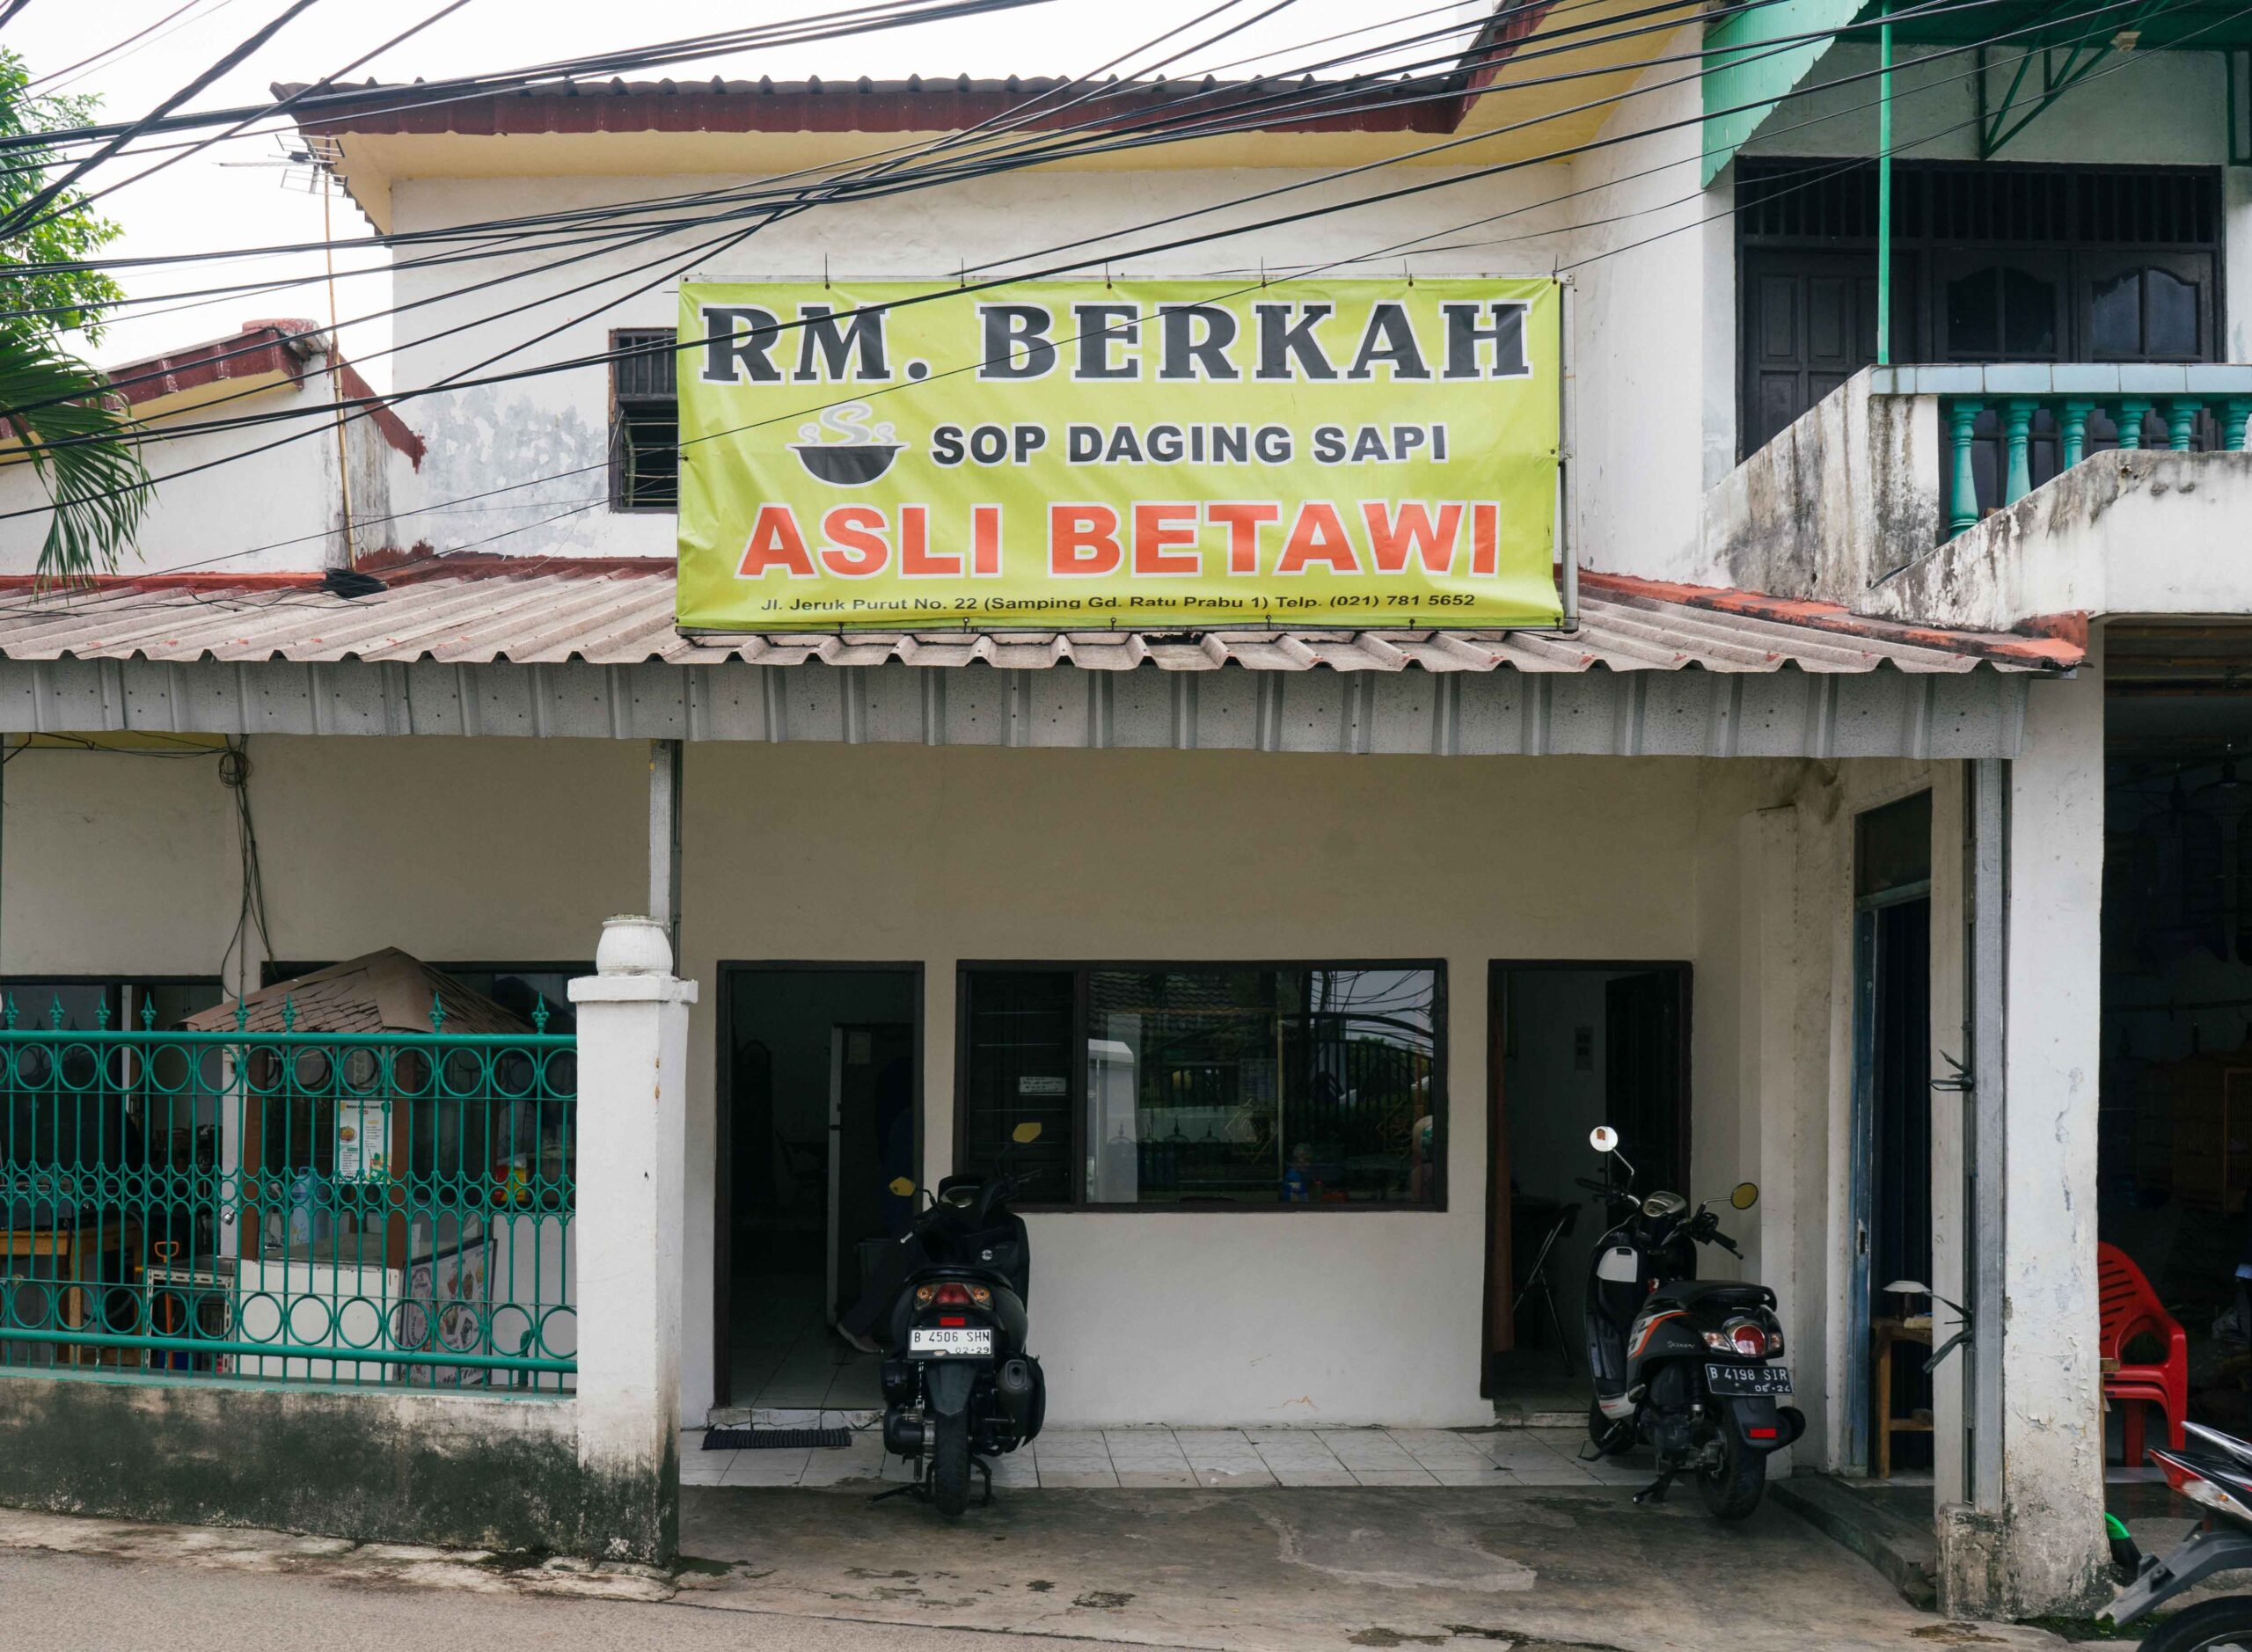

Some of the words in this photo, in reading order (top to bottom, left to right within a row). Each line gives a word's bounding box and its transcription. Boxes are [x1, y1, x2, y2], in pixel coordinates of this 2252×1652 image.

[701, 305, 928, 382] RM.
[979, 303, 1530, 379] BERKAH
[932, 426, 1047, 464] SOP
[1070, 426, 1291, 463] DAGING
[1314, 426, 1446, 463] SAPI
[740, 507, 999, 576] ASLI
[1050, 503, 1497, 574] BETAWI
[761, 599, 782, 610] Jl.
[789, 598, 844, 610] Jeruk
[852, 599, 908, 610] Purut
[914, 598, 947, 610] No.
[954, 597, 977, 610] 22
[984, 597, 1081, 611] (Samping
[1087, 596, 1122, 609] Gd.
[1130, 596, 1176, 608] Ratu
[1183, 596, 1243, 608] Prabu
[1251, 596, 1269, 610] 1)
[1275, 596, 1322, 609] Telp.
[1329, 596, 1379, 609] (021)
[1386, 595, 1420, 606] 781
[1428, 594, 1475, 606] 5652
[914, 1331, 922, 1343] B
[928, 1331, 959, 1343] 4506
[966, 1331, 990, 1342] SHN
[1709, 1366, 1719, 1379] B
[1724, 1367, 1756, 1381] 4198
[1763, 1368, 1788, 1381] SIR
